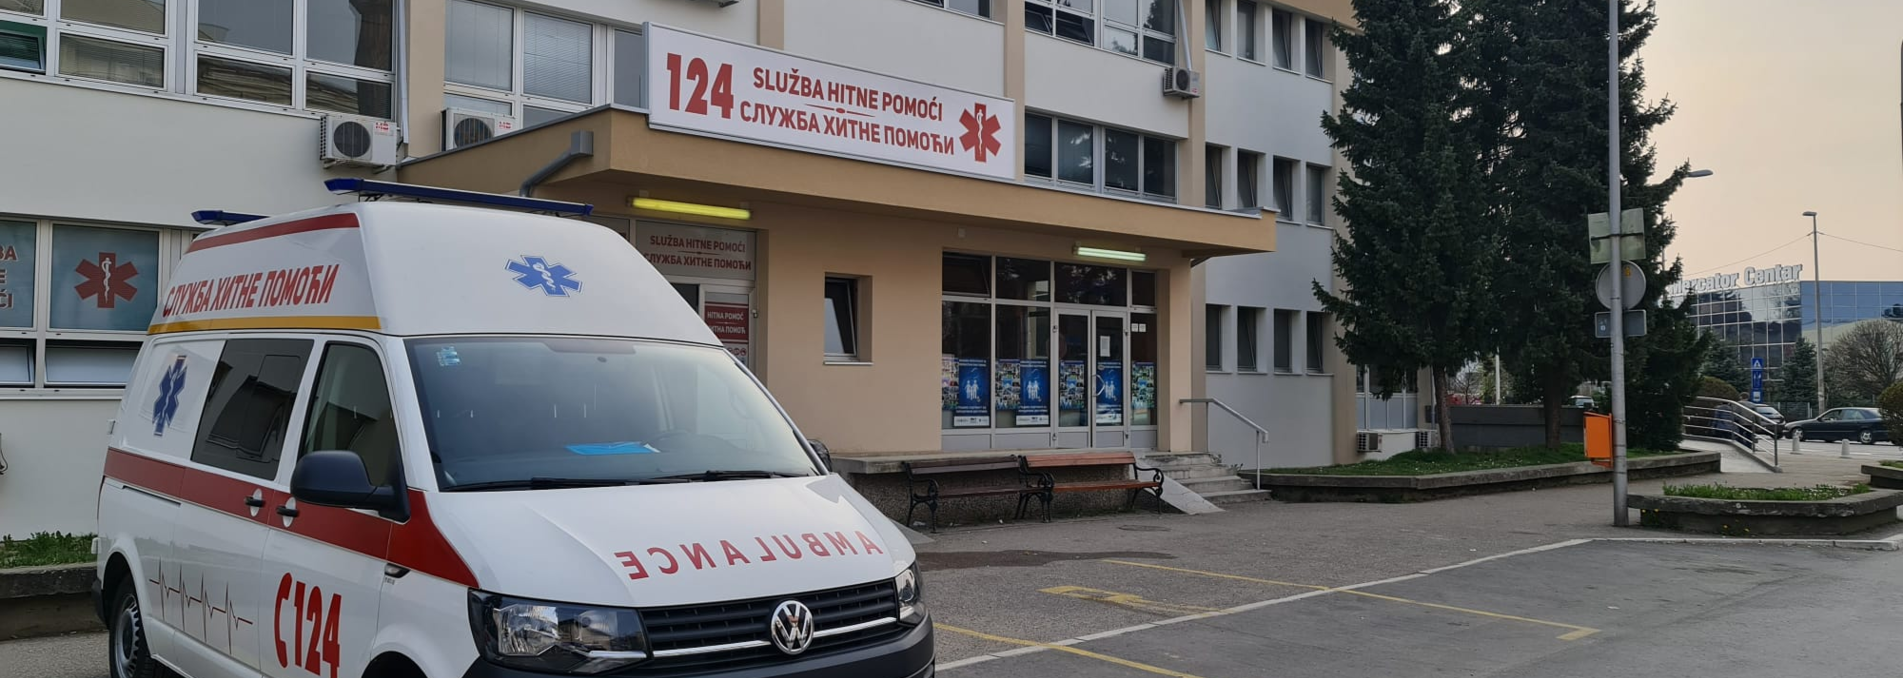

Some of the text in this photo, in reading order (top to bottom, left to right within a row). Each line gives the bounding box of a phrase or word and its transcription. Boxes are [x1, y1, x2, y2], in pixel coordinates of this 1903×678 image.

[667, 52, 734, 120] 124
[753, 67, 943, 122] SLUŽBA HITNE POMOĆI
[740, 101, 955, 156] СЛУЖБА ХИТНЕ ПОМОЋИ
[650, 234, 746, 253] SLUŽBA HITNE POMOĆI
[683, 255, 713, 268] ХИТНЕ
[714, 257, 752, 271] ПОМОЋИ
[162, 263, 340, 318] СЛУЖБА ХИТНЕ ПОМОЋИ
[1744, 263, 1803, 286] Centar
[707, 311, 724, 320] HITNA
